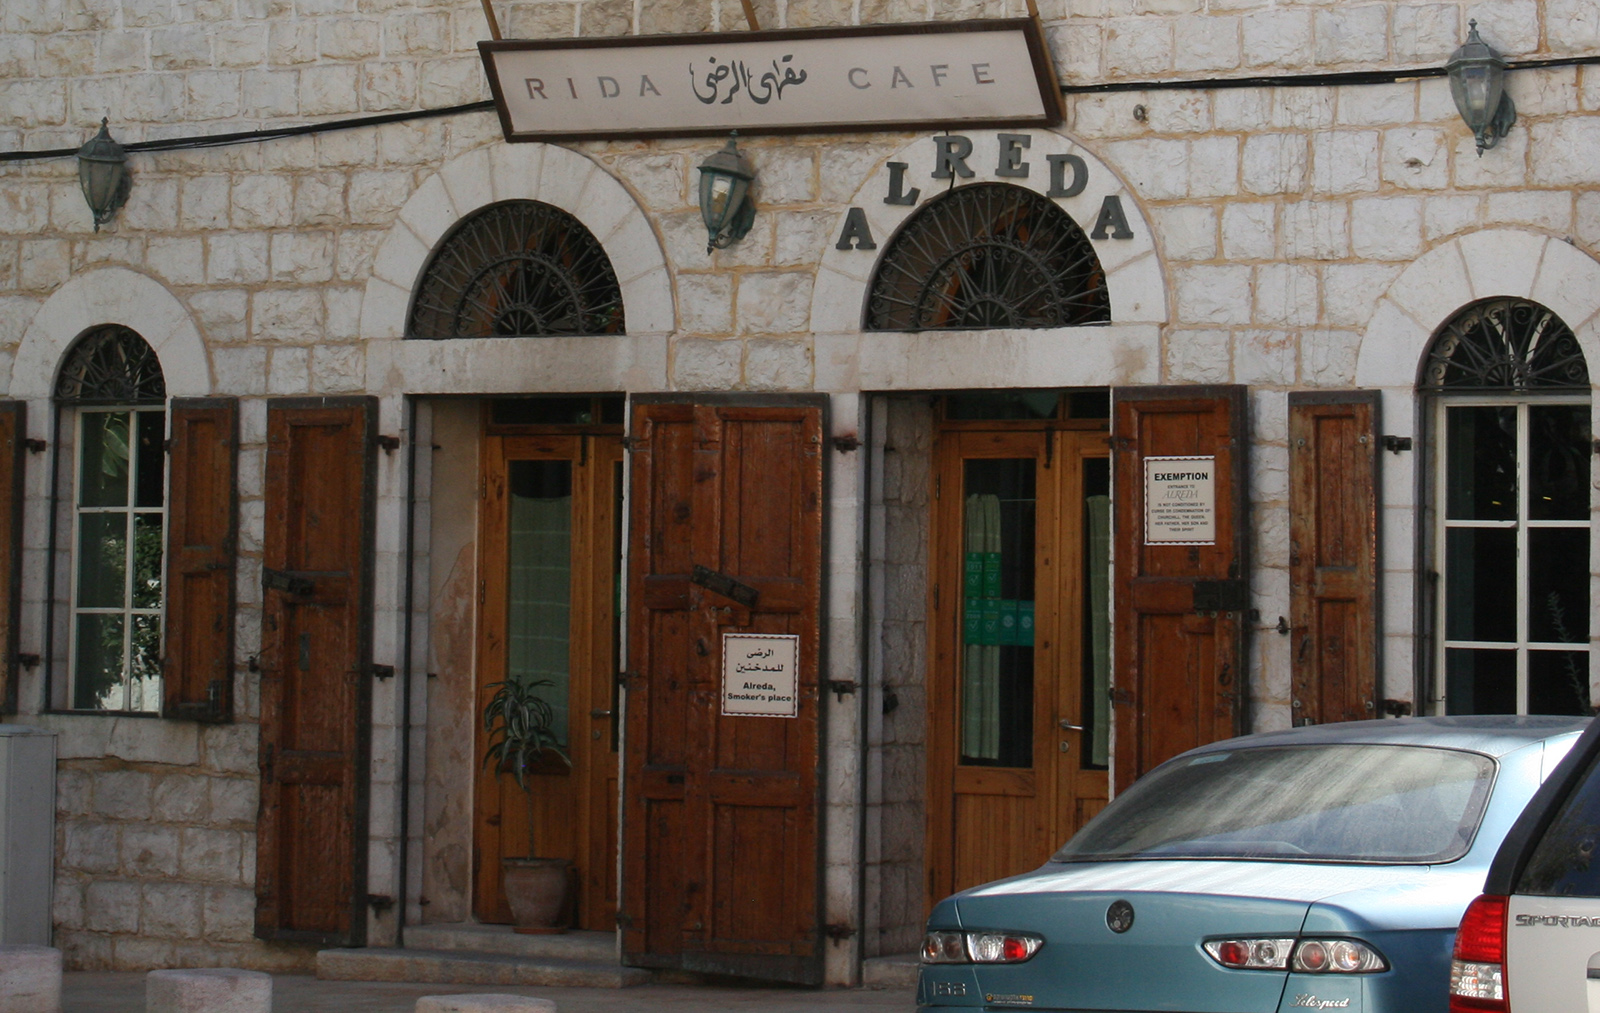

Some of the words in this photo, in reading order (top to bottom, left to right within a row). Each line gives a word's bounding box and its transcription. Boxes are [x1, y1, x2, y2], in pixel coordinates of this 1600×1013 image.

[747, 54, 807, 104] مقهى
[848, 63, 995, 91] CAFE
[525, 74, 662, 100] RIDA
[836, 133, 1134, 250] ALREDA
[1154, 472, 1208, 480] EXEMPTION
[1163, 489, 1199, 501] ALREDA
[746, 648, 774, 659] الرضى
[735, 662, 784, 673] للمدخنين
[743, 682, 776, 691] Alreda,
[728, 692, 766, 701] Smoker's
[768, 694, 792, 702] place
[1288, 993, 1350, 1010] Telespeed
